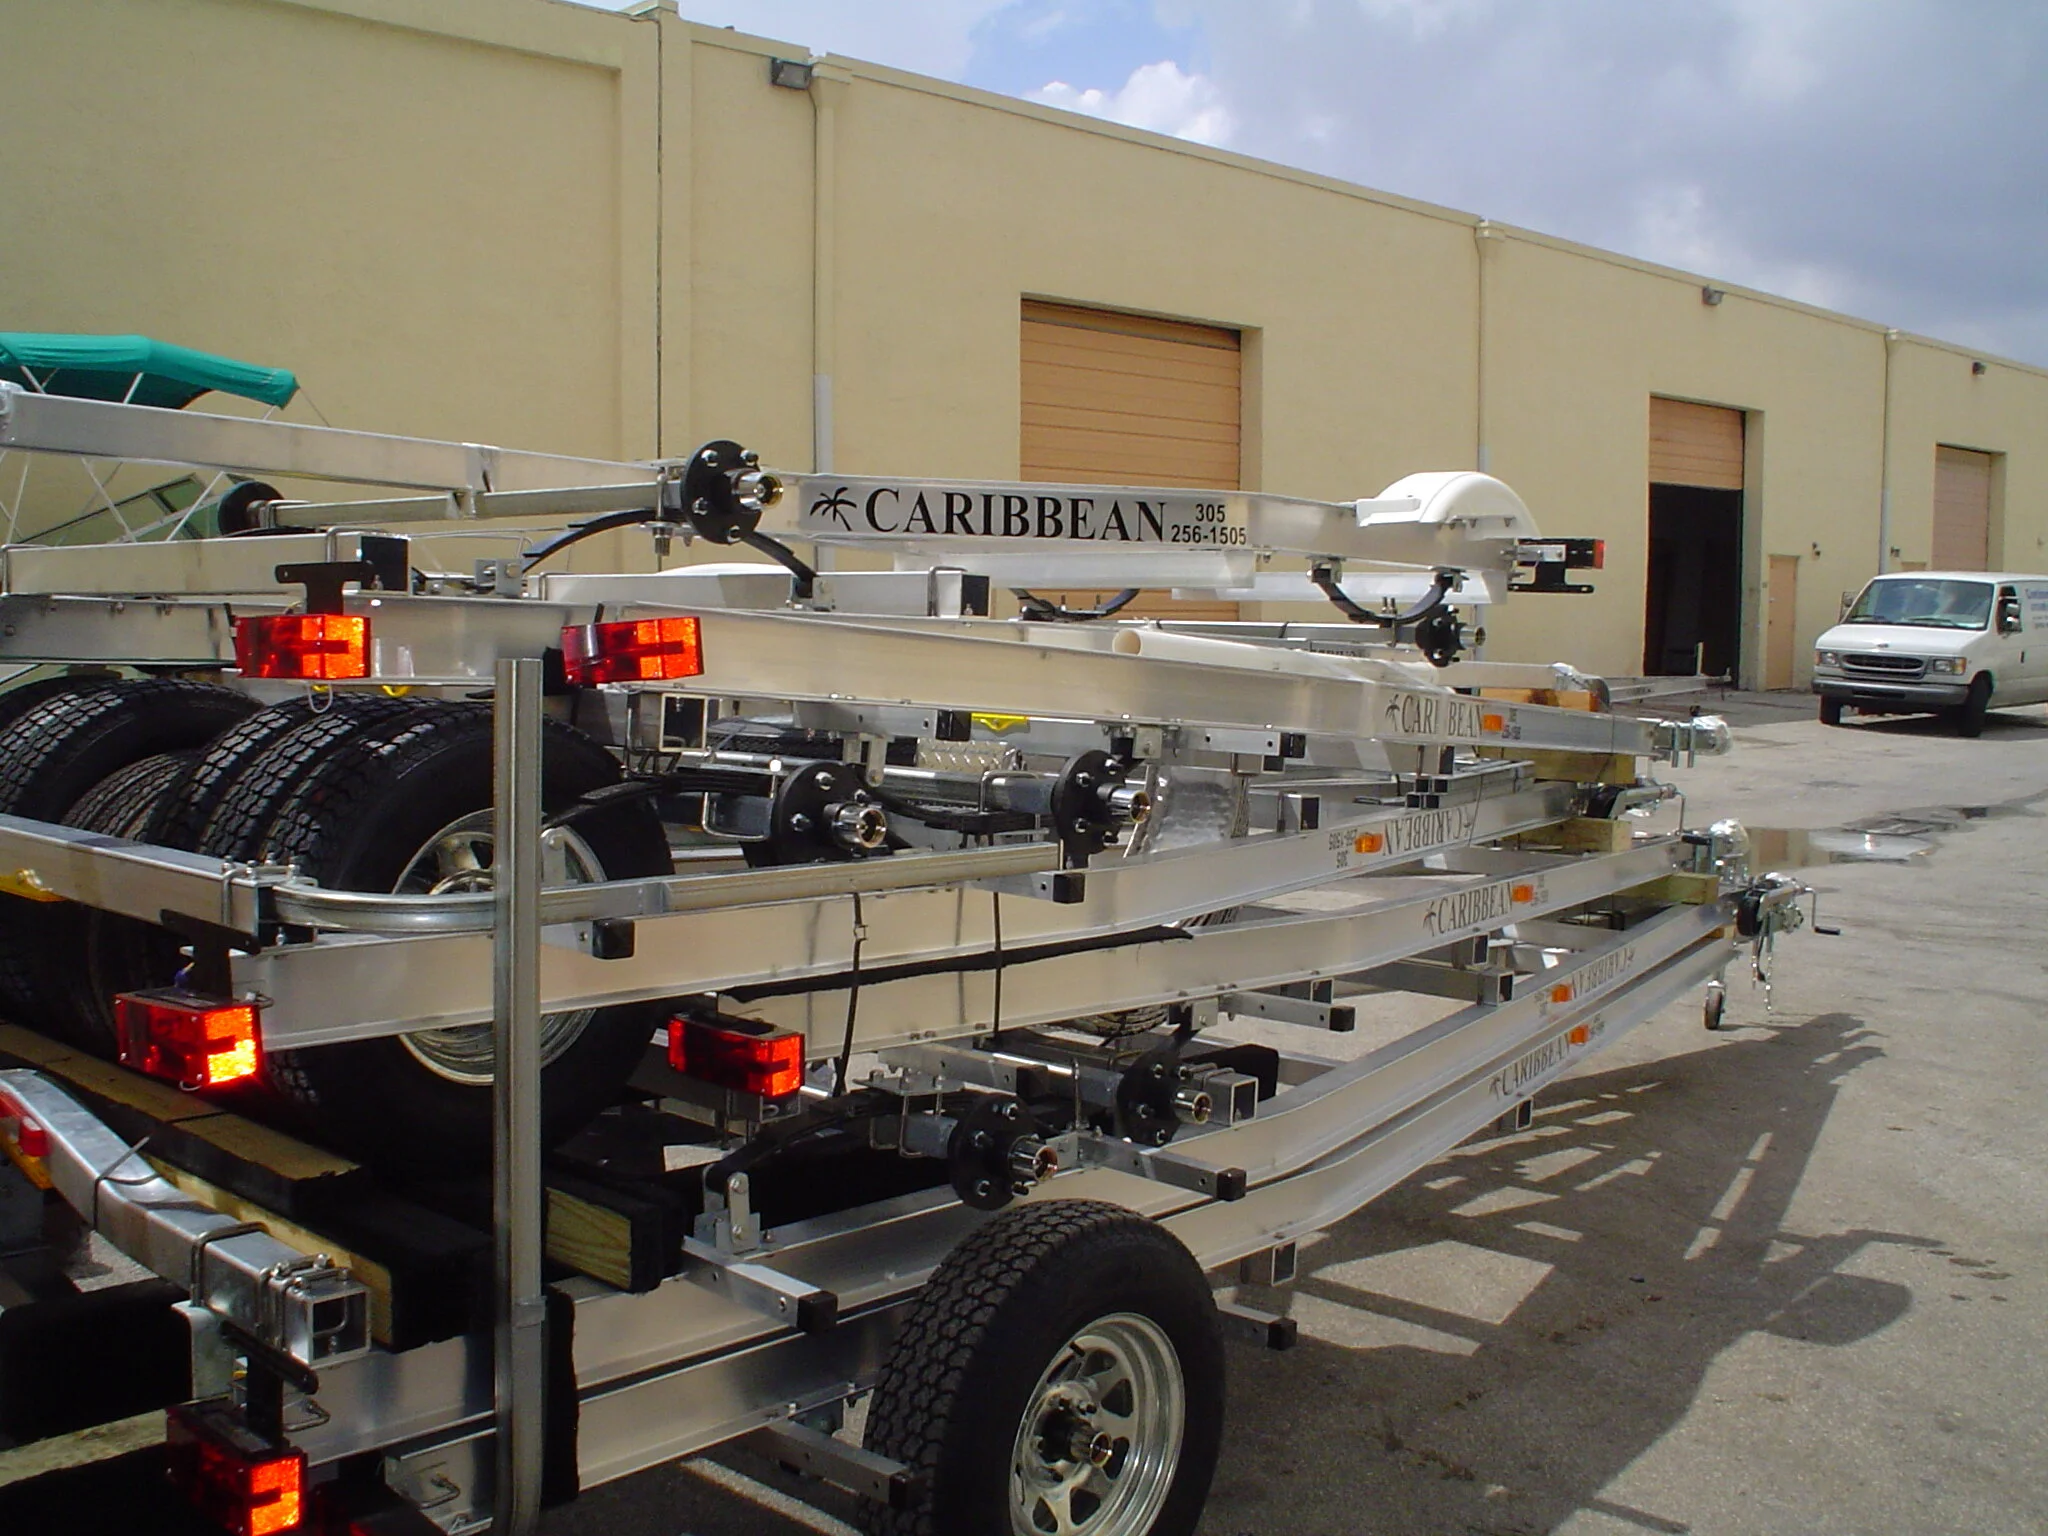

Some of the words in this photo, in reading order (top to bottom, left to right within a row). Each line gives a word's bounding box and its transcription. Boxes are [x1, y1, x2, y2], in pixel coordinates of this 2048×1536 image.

[865, 487, 1167, 543] CARIBBEAN
[1171, 525, 1247, 546] 256-1505
[1195, 503, 1226, 524] 305
[1402, 694, 1489, 738] CARIBEAN
[1382, 807, 1462, 856] CARIBBEAN
[1438, 880, 1514, 934] CARIBBEAN
